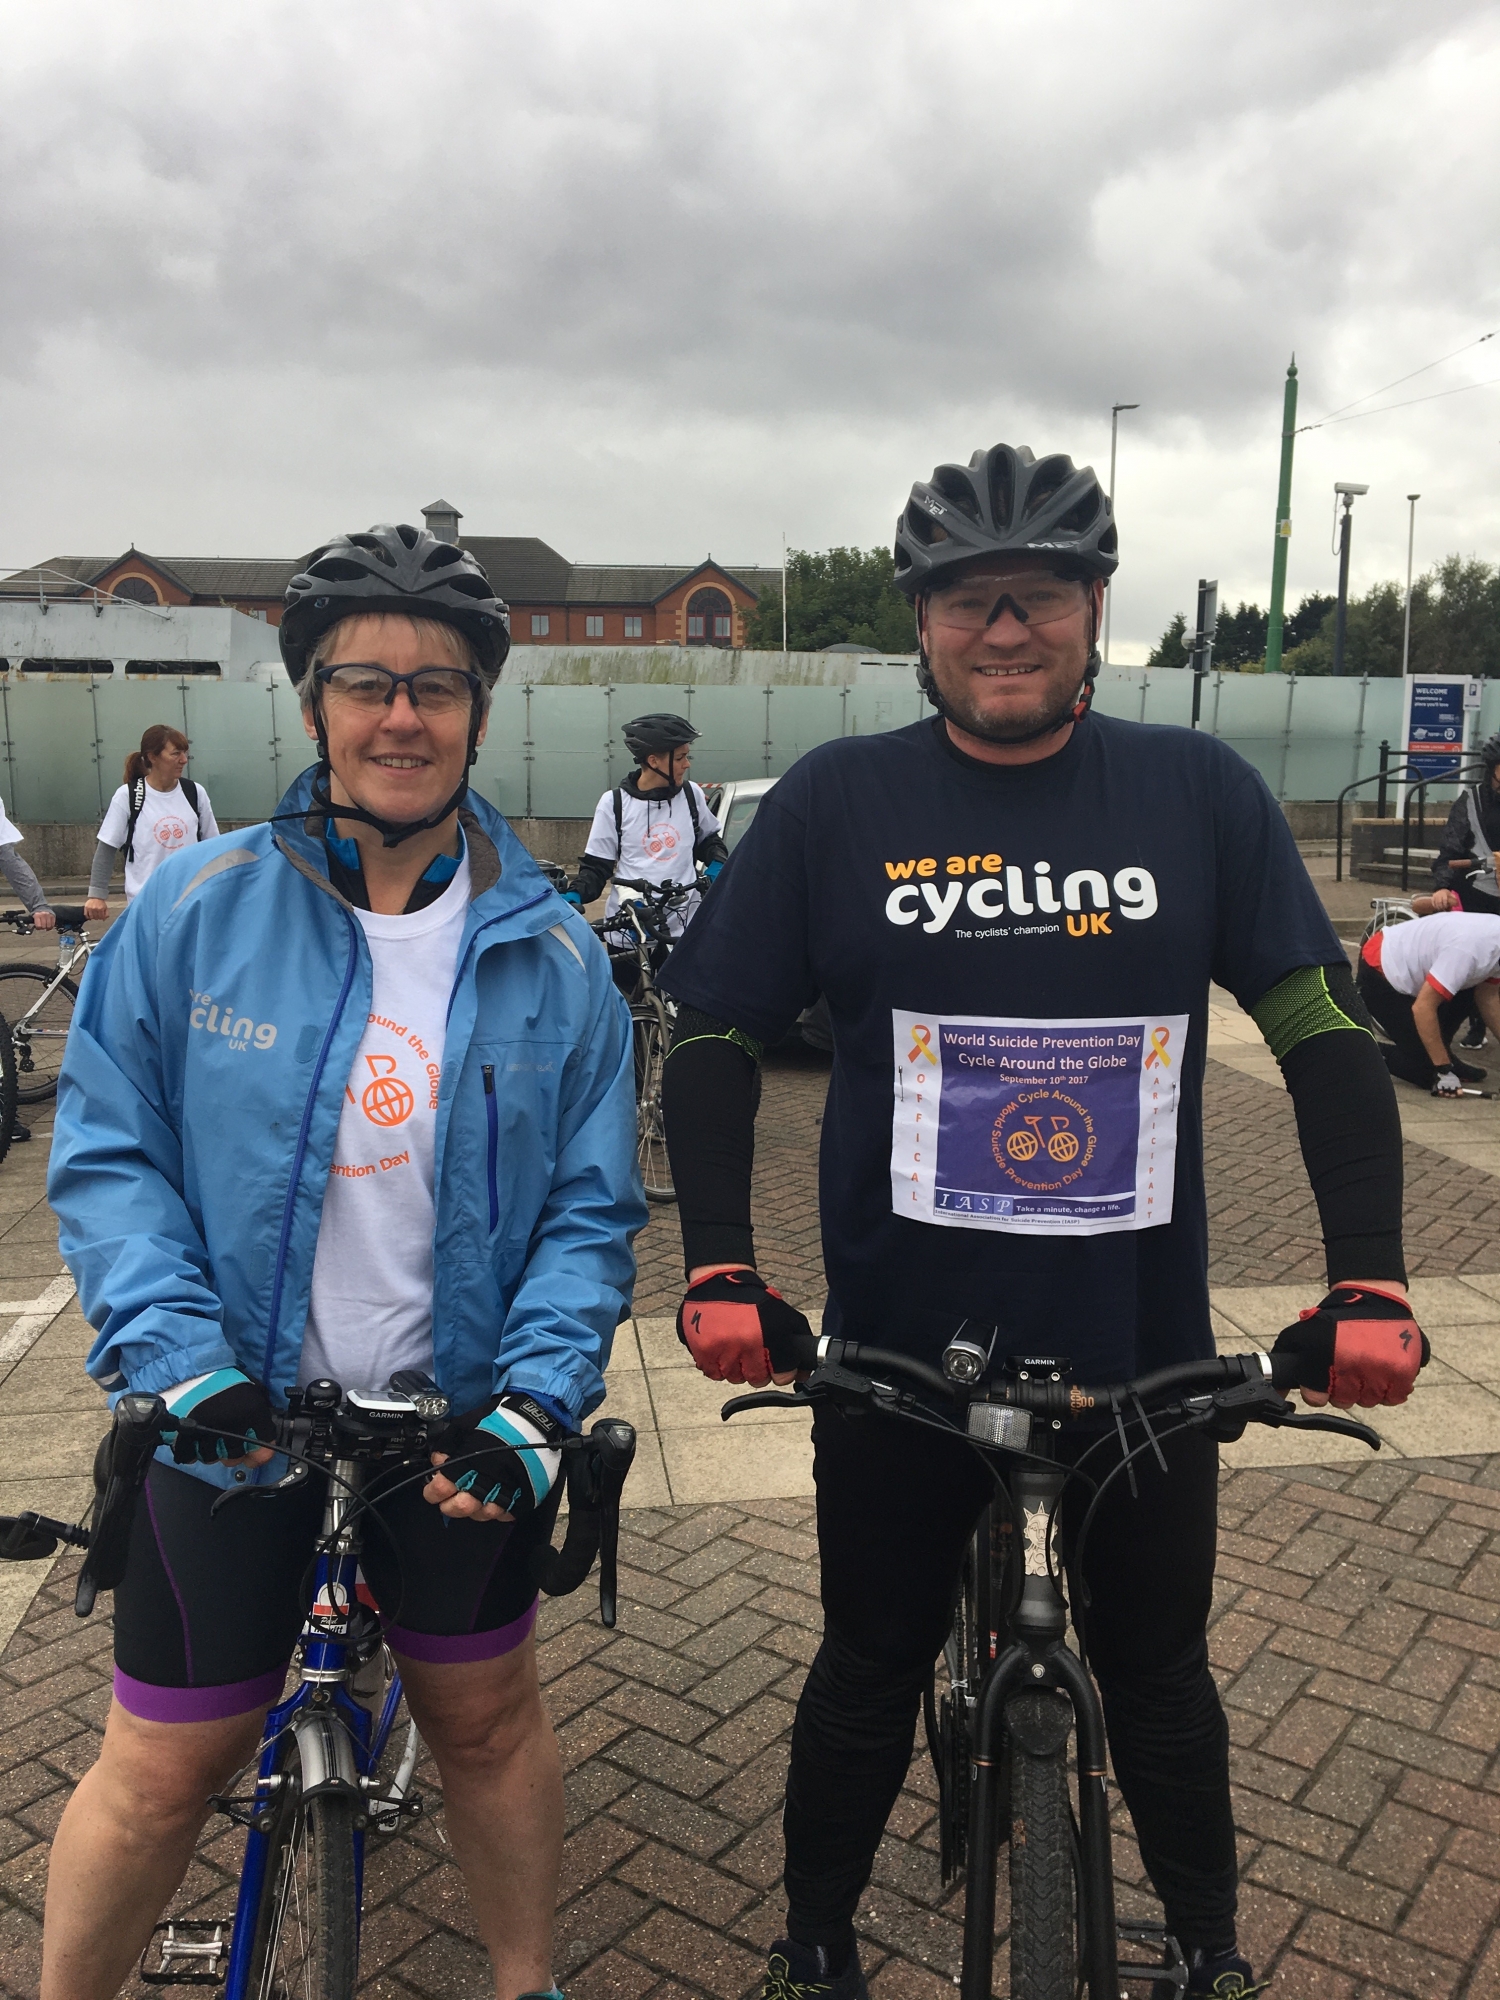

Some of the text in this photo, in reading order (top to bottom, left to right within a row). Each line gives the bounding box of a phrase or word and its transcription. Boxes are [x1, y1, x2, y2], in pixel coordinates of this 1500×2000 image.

[924, 495, 948, 516] MET
[885, 854, 1003, 880] we are
[885, 861, 1158, 934] cycling
[955, 928, 972, 939] The
[1014, 923, 1060, 937] champion
[1066, 911, 1113, 937] UK
[190, 1004, 278, 1050] cling
[367, 1013, 408, 1037] ound
[407, 1034, 429, 1060] the
[228, 1038, 249, 1052] UK
[943, 1033, 1141, 1049] World Suicide Prevention Day
[958, 1053, 1127, 1070] Cycle Around the Globe
[1000, 1073, 1088, 1085] September 10th 2017
[1018, 1089, 1097, 1167] Cycle Around the Globe
[992, 1101, 1083, 1190] World Suicide Prevention Day
[329, 1150, 410, 1177] ention Day
[935, 1209, 969, 1218] International
[970, 1213, 1002, 1221] Association
[1043, 1206, 1072, 1214] minute,
[1074, 1205, 1100, 1213] change
[1024, 1358, 1056, 1366] GARMIN
[369, 1411, 404, 1419] GARMIN
[522, 1401, 554, 1431] TEAM
